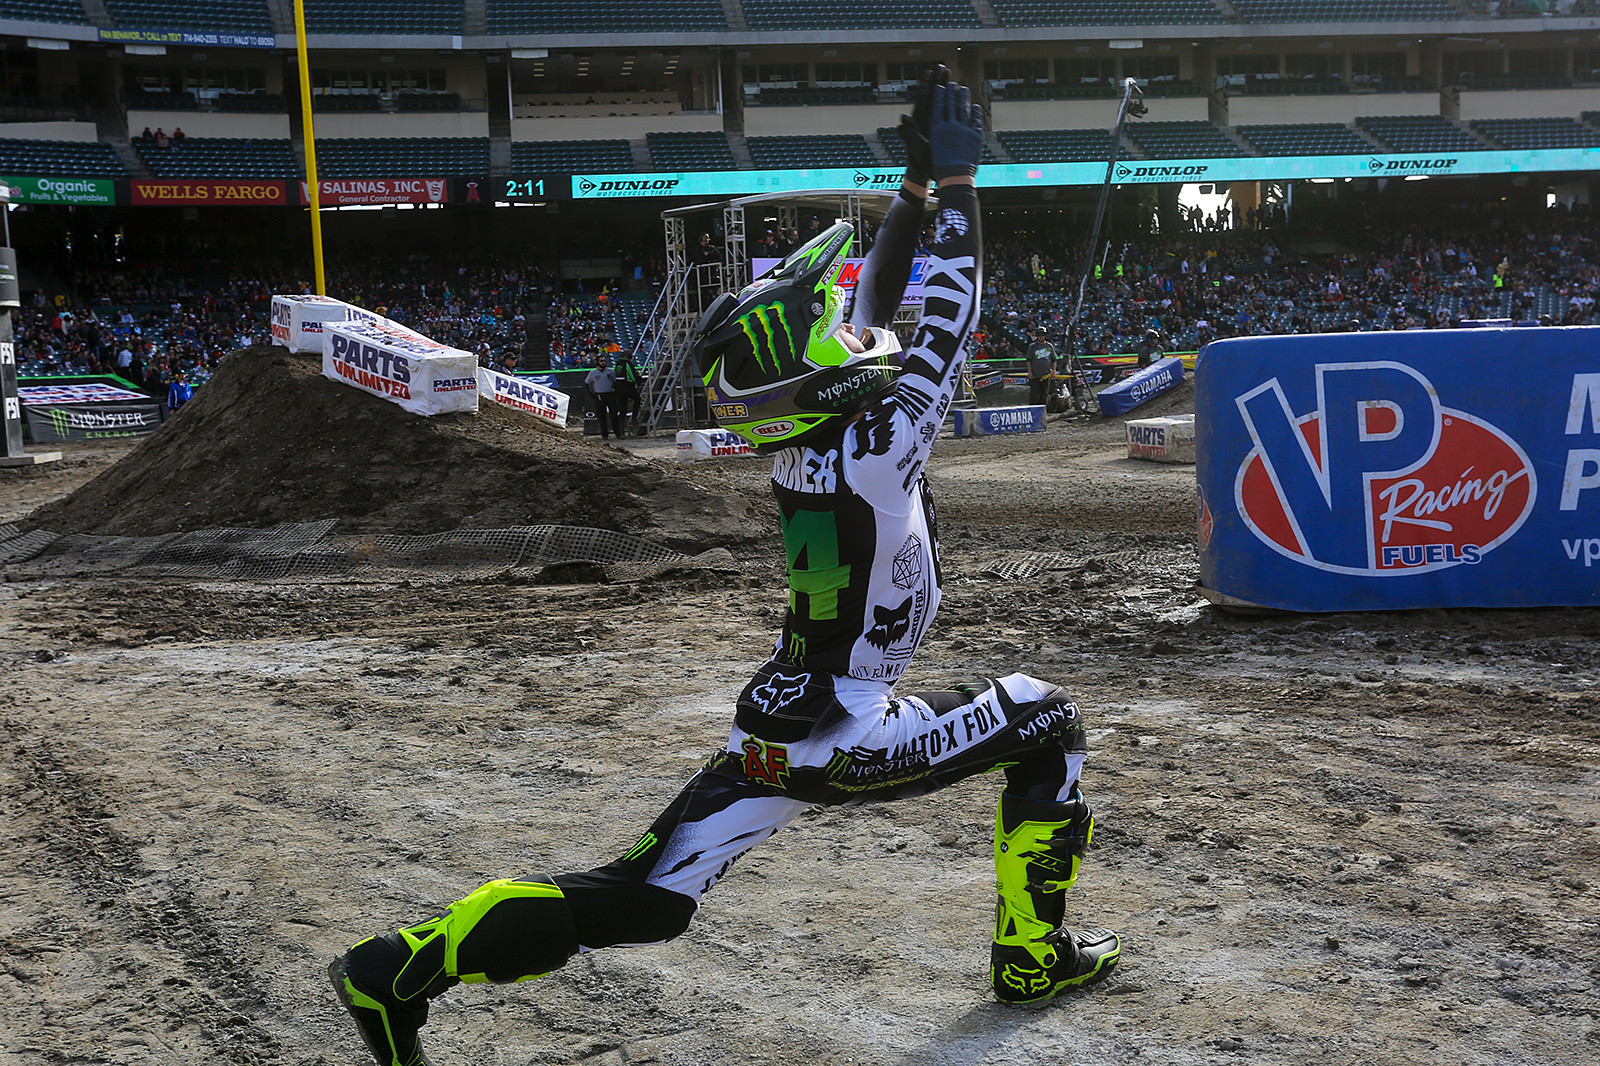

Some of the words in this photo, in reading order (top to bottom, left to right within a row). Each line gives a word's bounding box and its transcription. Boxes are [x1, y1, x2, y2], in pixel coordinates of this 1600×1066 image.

[147, 32, 161, 41] CALL
[168, 33, 182, 42] TEXT
[1133, 166, 1208, 177] DUNLOP
[1385, 159, 1458, 170] DUNLOP
[37, 179, 96, 194] Organic
[137, 185, 209, 199] WELLS
[213, 186, 280, 199] FARGO
[323, 181, 389, 195] SALINAS,
[394, 181, 425, 193] INC.
[505, 179, 544, 197] 2:11
[598, 180, 679, 191] DUNLOP
[30, 192, 51, 200] Fruits
[61, 193, 108, 202] Vegetables
[331, 334, 411, 384] PARTS
[332, 359, 412, 400] UNLIMITED
[433, 377, 477, 387] PARTS
[1140, 369, 1173, 395] YAMAHA
[433, 384, 477, 393] UNLIMITED
[494, 375, 559, 411] PARTS
[494, 393, 557, 421] UNLIMITED
[70, 411, 146, 429] MONSTER
[999, 411, 1034, 426] YAMAHA
[86, 430, 137, 439] ENERGY
[756, 424, 790, 435] BELL
[1129, 426, 1165, 446] PARTS
[1234, 360, 1441, 570] VP
[1379, 465, 1524, 543] Racing
[1382, 543, 1482, 566] FUELS
[961, 699, 1001, 743] FOX
